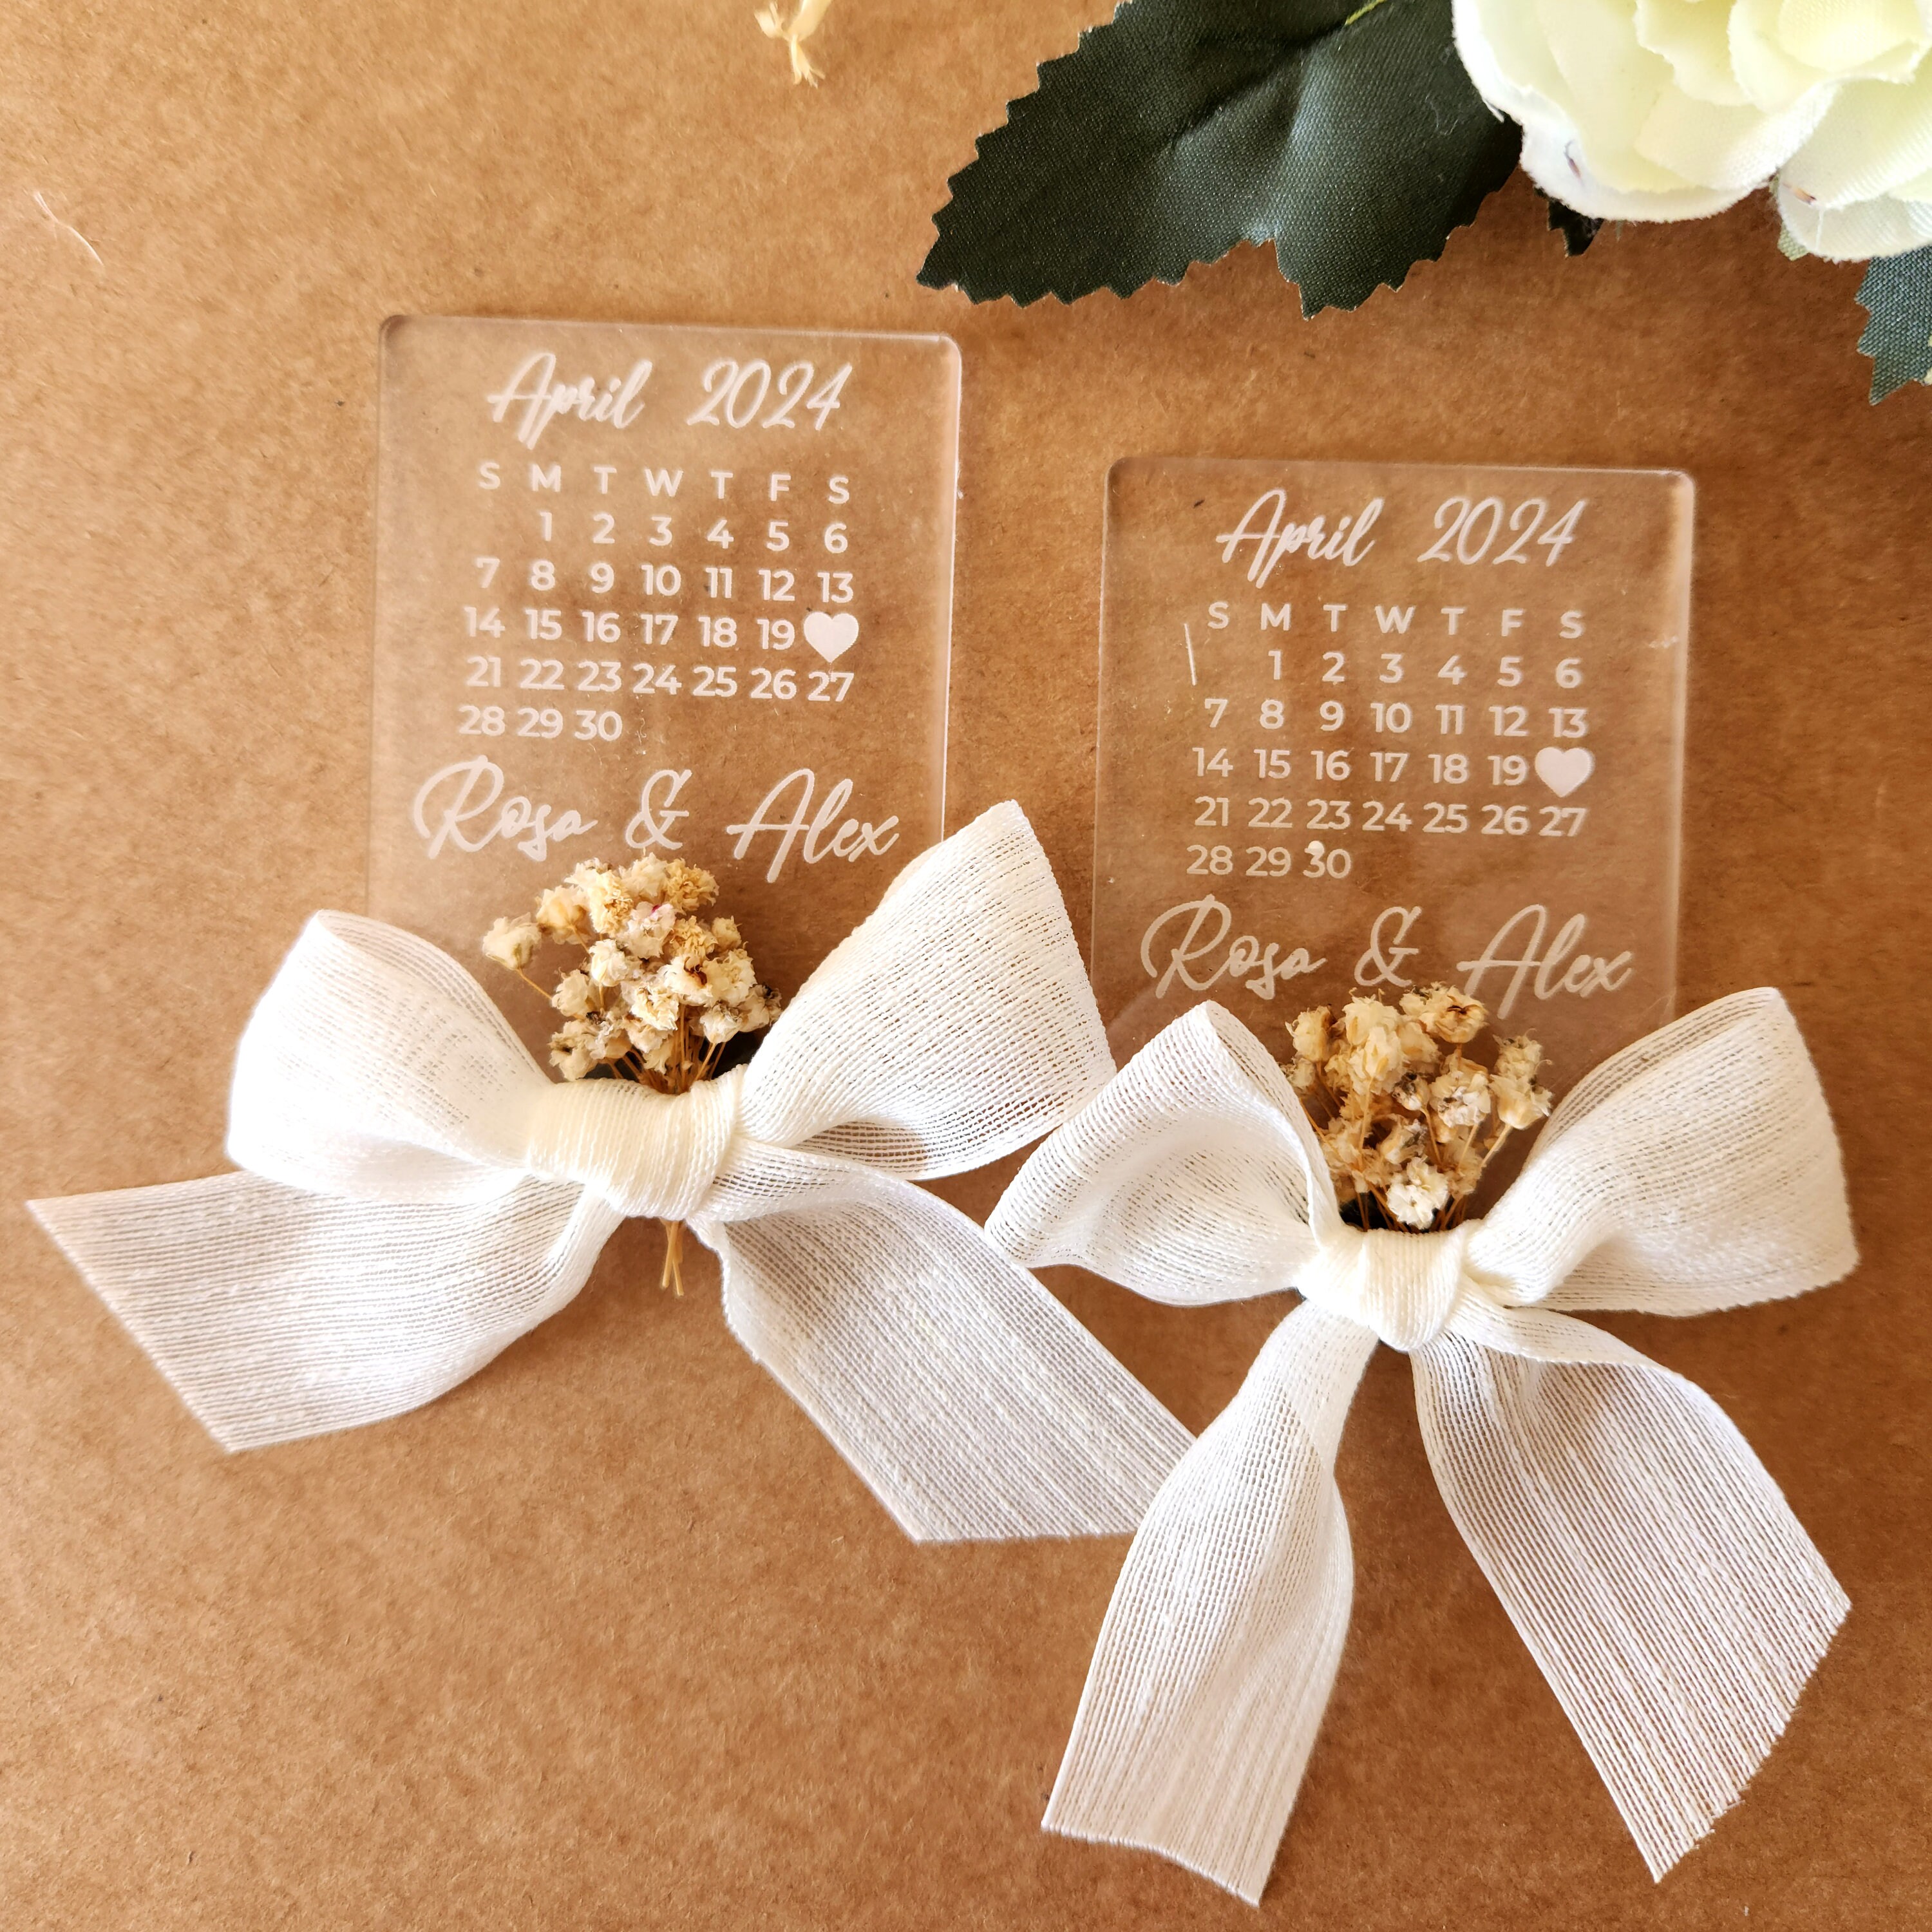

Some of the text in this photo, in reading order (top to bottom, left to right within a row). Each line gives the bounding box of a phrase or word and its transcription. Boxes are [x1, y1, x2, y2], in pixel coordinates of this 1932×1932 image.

[487, 353, 853, 450] April 2024
[478, 462, 849, 504] S M T W T F S
[540, 512, 848, 553] 1 2 3 4 5 6
[1216, 489, 1588, 589] April 2024
[477, 558, 854, 603] 7 8 9 10 11 12 13
[464, 607, 795, 650] 14 15 16 17 18 19
[1208, 601, 1582, 639] S M T W T F S
[467, 656, 854, 702] 21 22 23 24 25 26 27
[1268, 650, 1580, 688] 1 2 3 4 5 6
[459, 705, 622, 741] 28 29 30
[1204, 698, 1587, 738] 7 8 9 10 11 12 13
[1193, 748, 1527, 785] 14 15 16 17 18 19
[412, 755, 899, 884] Rosa & Alex
[1195, 797, 1586, 837] 21 22 23 24 25 26 27
[1187, 845, 1350, 879] 28 29 30
[1141, 894, 1632, 1019] Rosa & Alex
